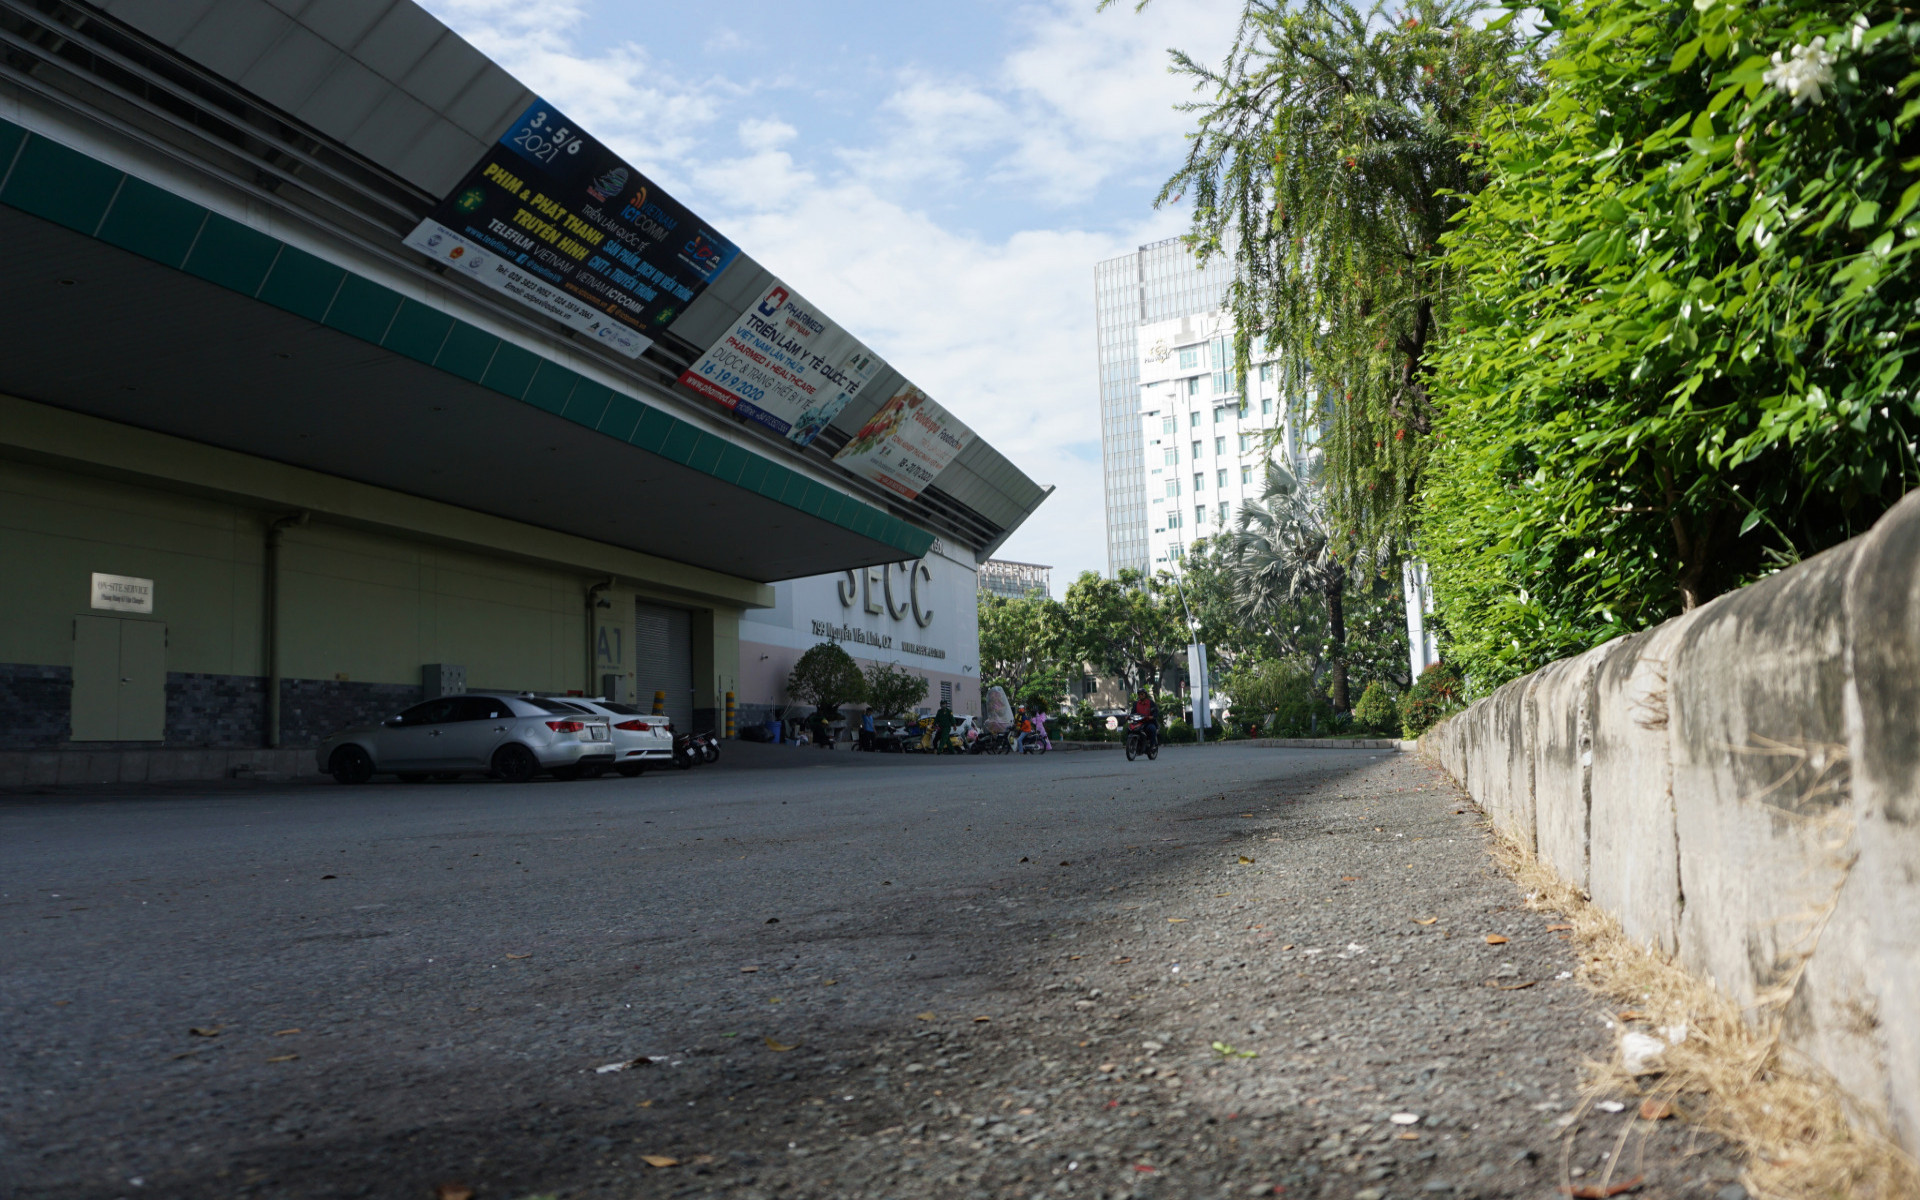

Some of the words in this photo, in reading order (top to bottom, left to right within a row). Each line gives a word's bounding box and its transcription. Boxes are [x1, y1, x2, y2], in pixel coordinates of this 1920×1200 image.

[513, 128, 559, 163] 2021
[531, 112, 546, 128] 3
[552, 128, 582, 154] 5/6
[483, 163, 523, 194] PHIM
[519, 189, 530, 201] &
[530, 193, 567, 220] PHÁT
[563, 214, 604, 245] THANH
[621, 204, 669, 242] ICTCOMM
[488, 218, 535, 250] TELEFILM
[534, 245, 574, 273] VIETNAM
[513, 208, 561, 244] TRUYỀN
[557, 237, 589, 261] HÌNH
[496, 264, 509, 275] Tel:
[508, 272, 522, 282] 028
[520, 279, 537, 290] 3823
[554, 296, 567, 305] 024
[578, 309, 593, 319] 2063
[504, 282, 524, 295] Email:
[576, 270, 610, 293] VIETNAM
[606, 288, 644, 313] ICTCOMM
[783, 317, 810, 337] VIETNAM
[784, 302, 825, 335] PHARMEDI
[736, 326, 755, 341] VIỆT
[753, 338, 772, 353] NAM
[746, 313, 781, 342] TRIỂN
[800, 350, 811, 360] Y
[809, 355, 826, 370] TẾ
[820, 365, 847, 386] QUỐC
[845, 380, 860, 394] TẾ
[712, 347, 743, 369] DƯỢC
[739, 364, 749, 374] &
[747, 367, 775, 388] TRANG
[726, 336, 766, 364] PHARMED
[770, 364, 816, 395] HEALTHCARE
[686, 376, 736, 405] www.pharmed.vn
[598, 625, 621, 664] A1
